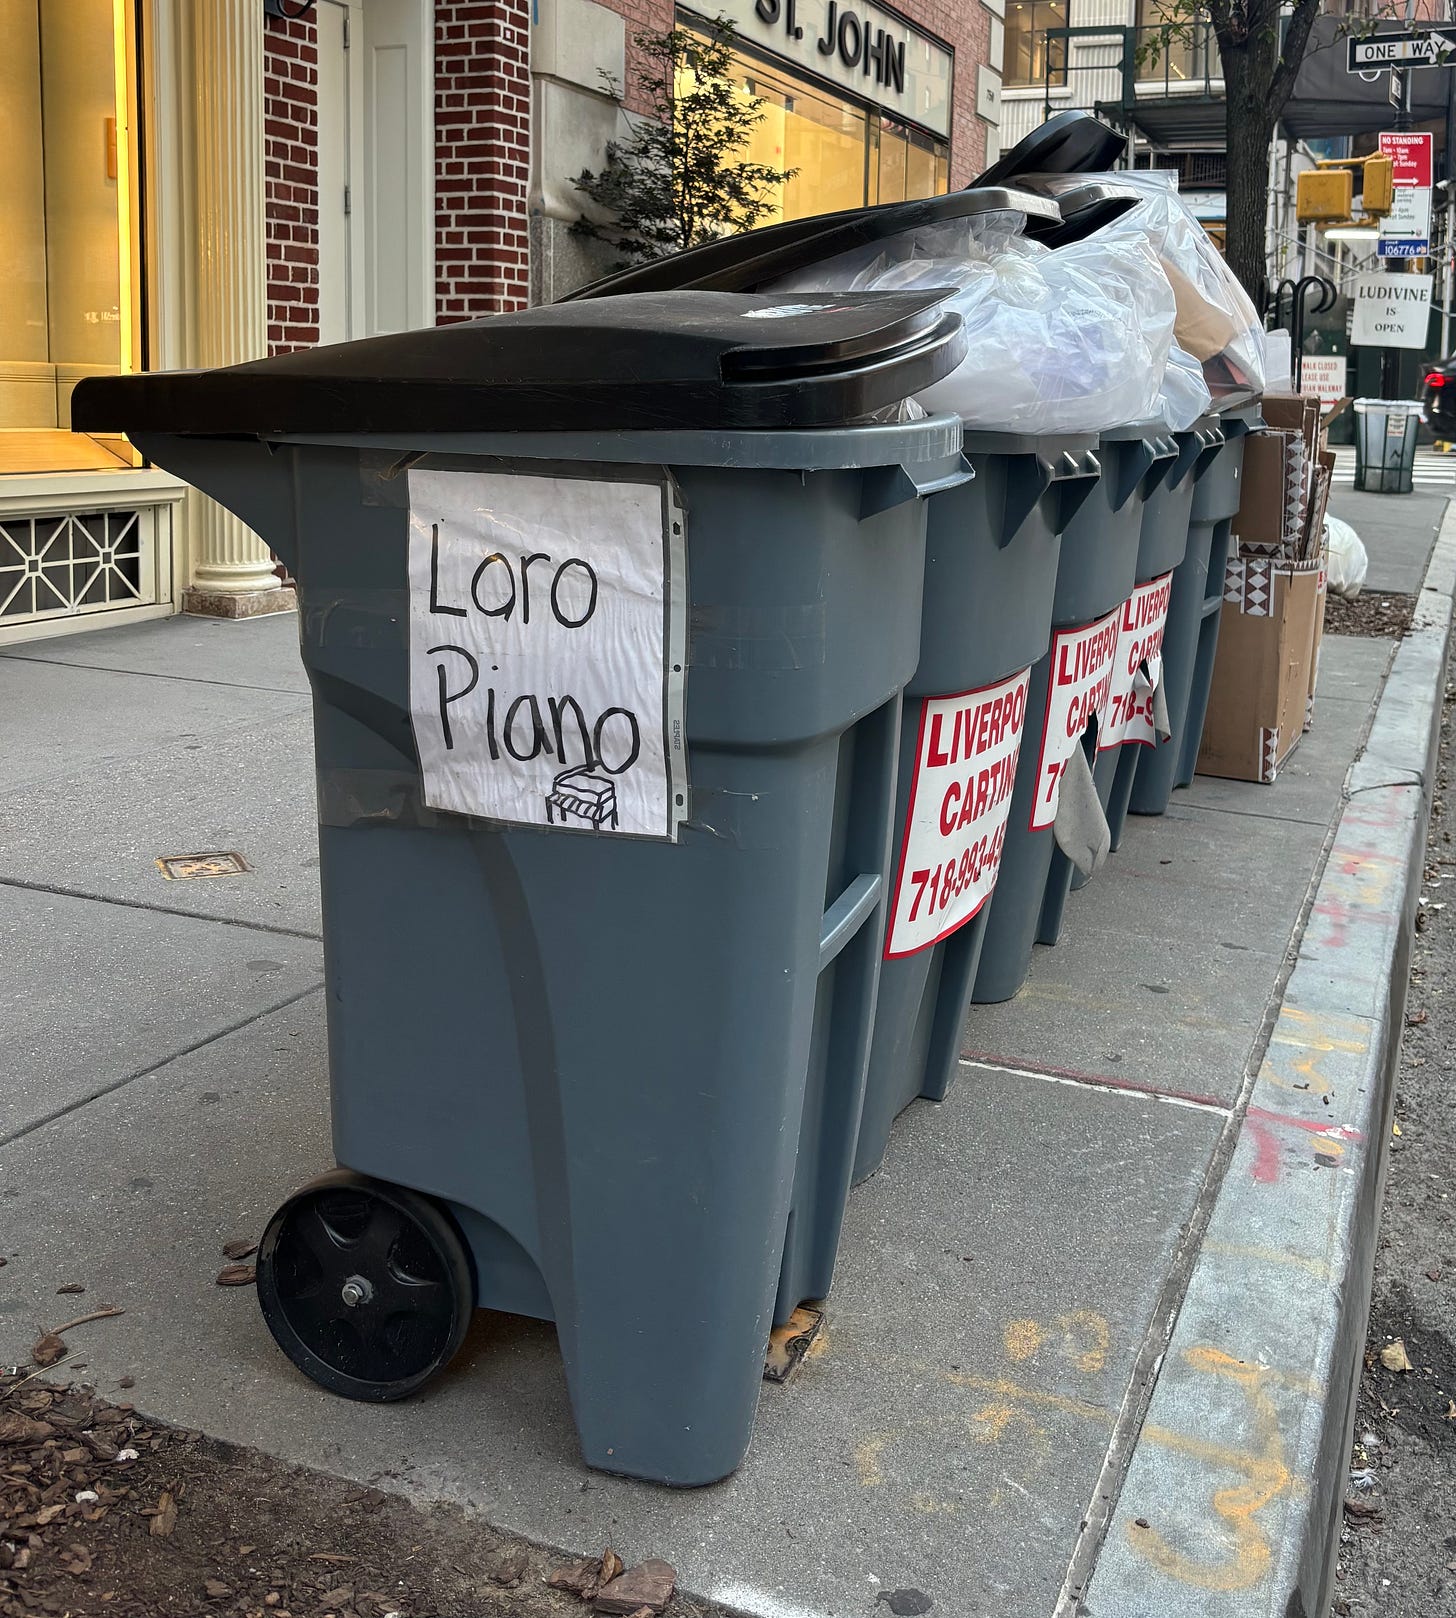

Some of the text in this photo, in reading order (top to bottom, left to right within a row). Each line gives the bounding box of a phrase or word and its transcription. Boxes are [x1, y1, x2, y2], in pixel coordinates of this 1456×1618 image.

[818, 0, 906, 94] JOHN
[1365, 40, 1446, 60] ONE WAY
[1382, 136, 1424, 145] NO STANDING
[1385, 245, 1415, 256] 106776
[1359, 286, 1428, 302] LUDIVINE
[1386, 306, 1397, 316] IS
[1374, 323, 1405, 333] OPEN
[1317, 362, 1338, 371] CLOSED
[1319, 373, 1330, 381] USE
[1121, 582, 1171, 633] LIVERPO
[1057, 619, 1118, 686] LIVERPO
[426, 645, 641, 775] Piano
[926, 678, 1029, 768] LIVERPO
[1110, 691, 1154, 727] 718-9
[939, 744, 1020, 837] CARTIN
[908, 820, 1006, 923] 718-993-45
